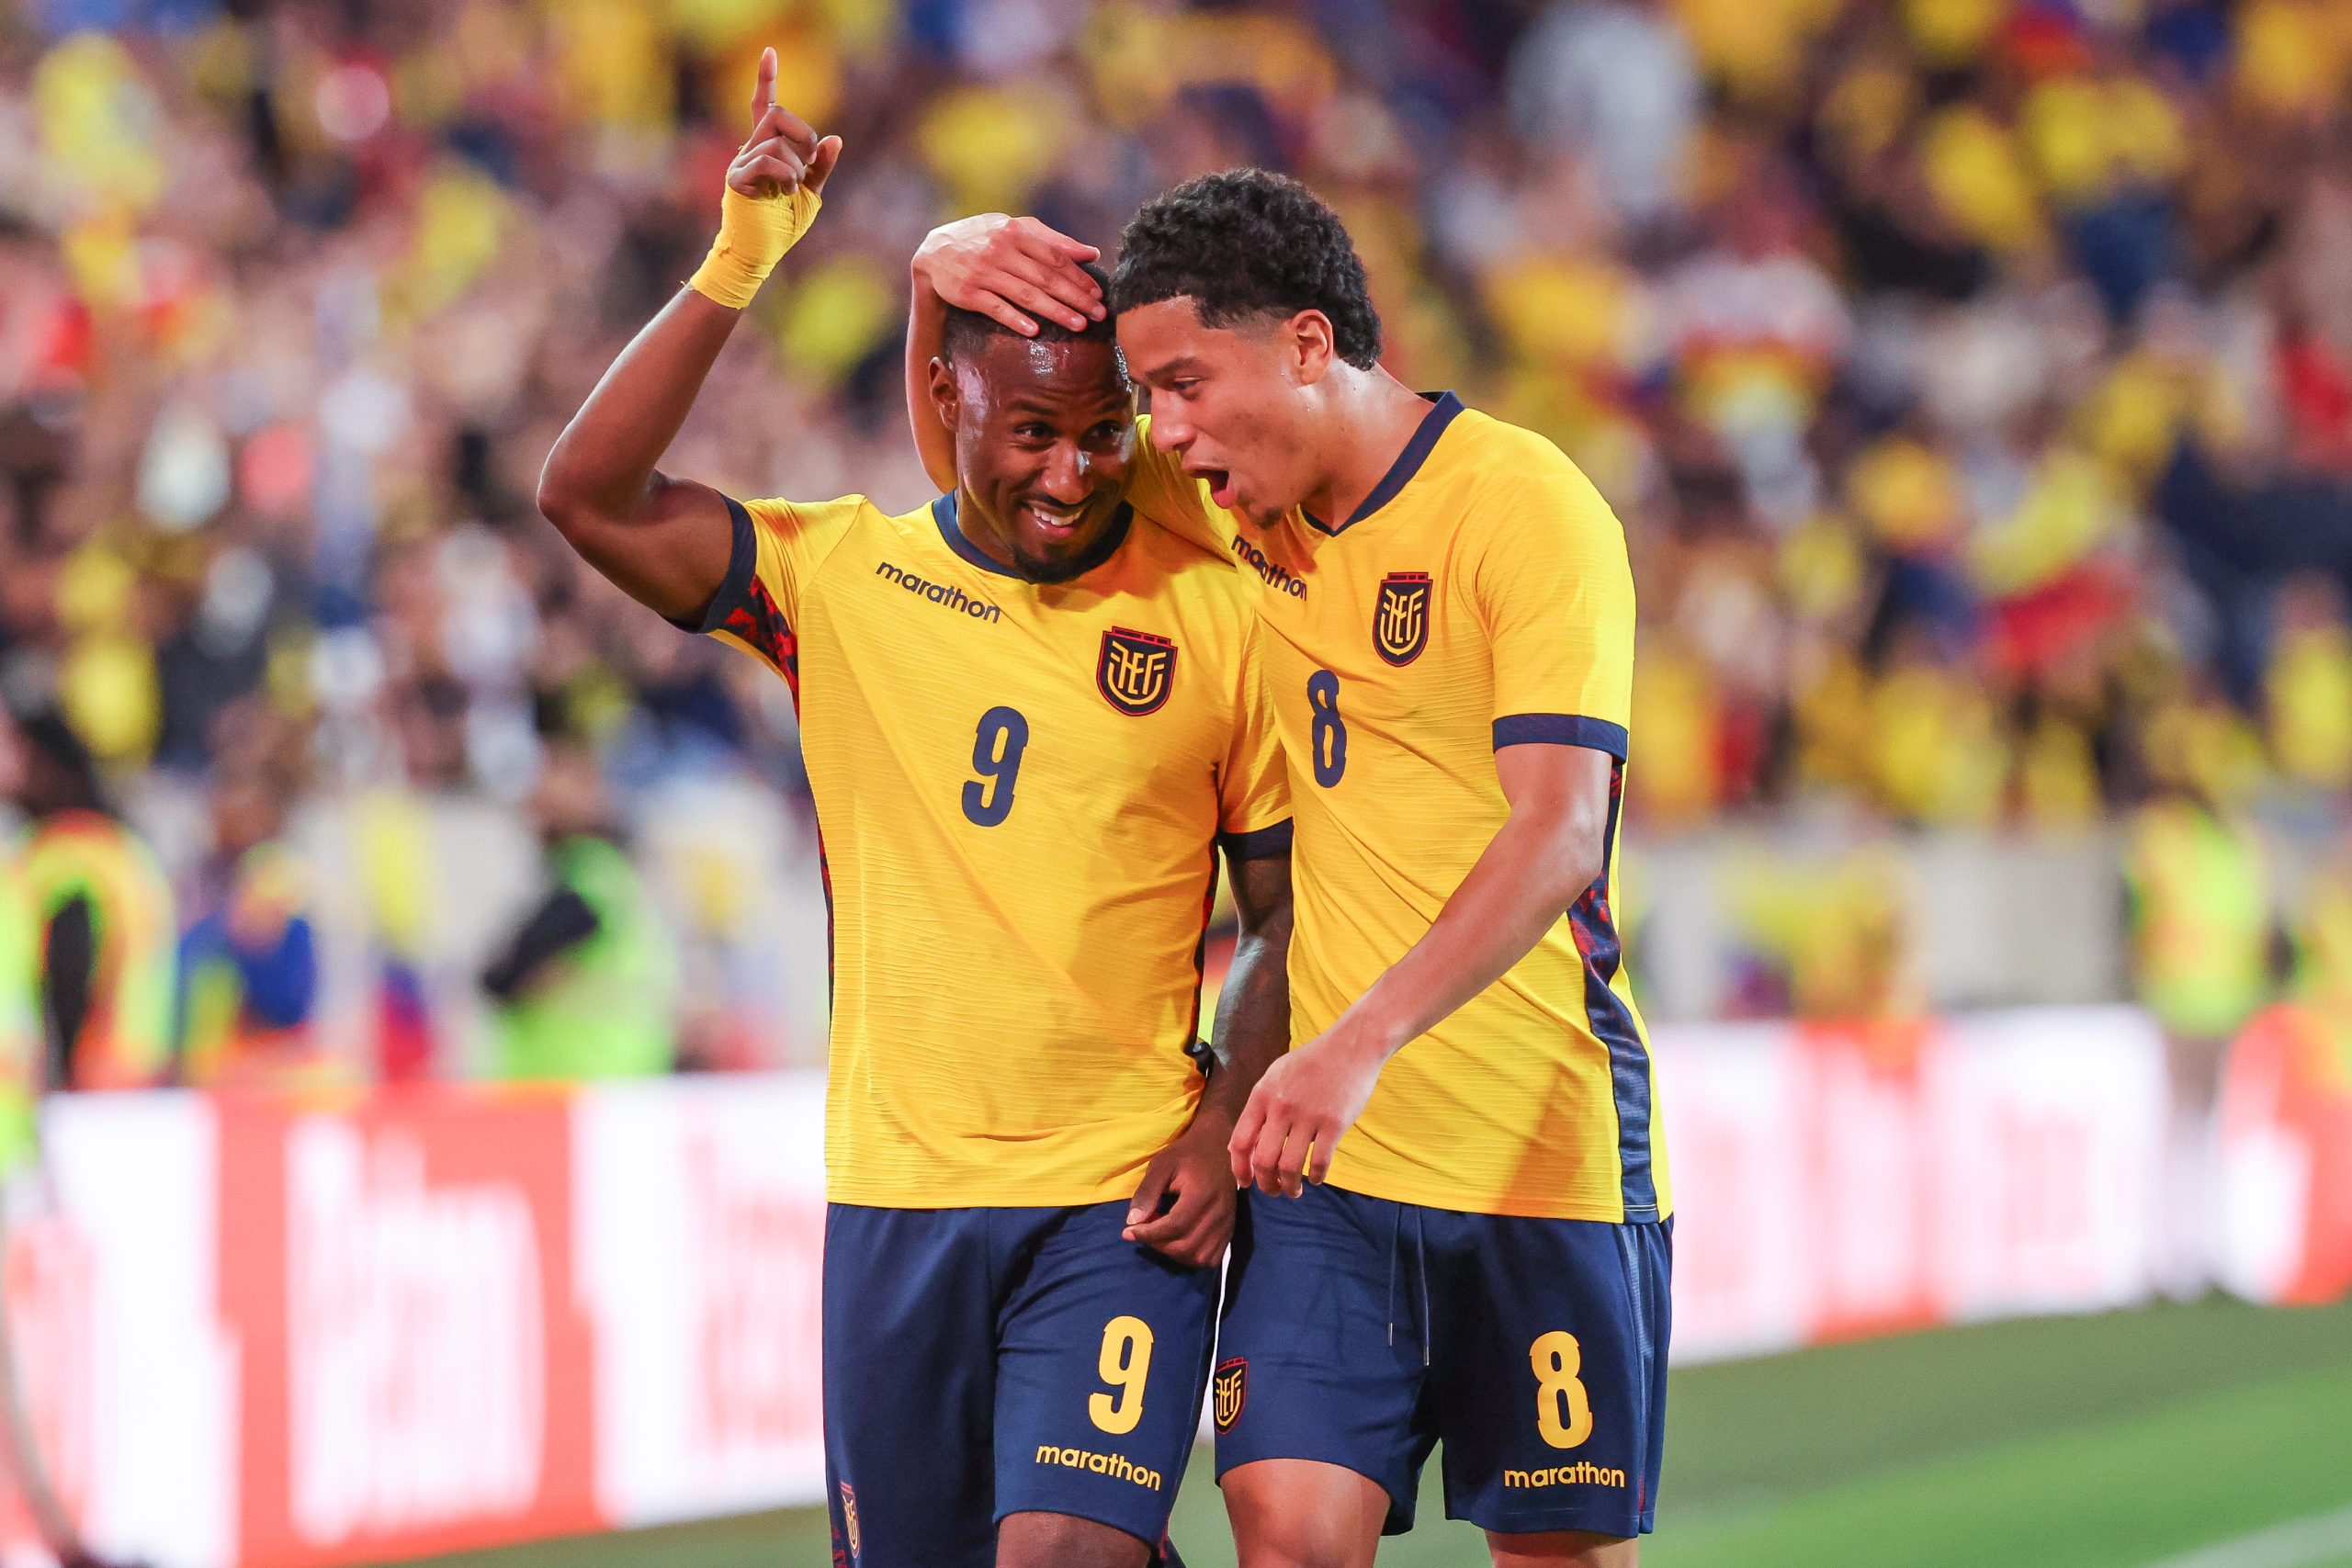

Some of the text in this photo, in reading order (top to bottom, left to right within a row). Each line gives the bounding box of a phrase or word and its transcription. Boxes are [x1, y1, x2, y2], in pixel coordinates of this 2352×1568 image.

[876, 561, 1001, 623] marathon
[1231, 535, 1307, 603] maathon
[962, 706, 1029, 826] 9
[1307, 670, 1347, 787] 8
[1089, 1315, 1155, 1434] 9
[1530, 1331, 1593, 1449] 8
[1035, 1444, 1161, 1491] marathon
[1504, 1461, 1625, 1488] marathon
